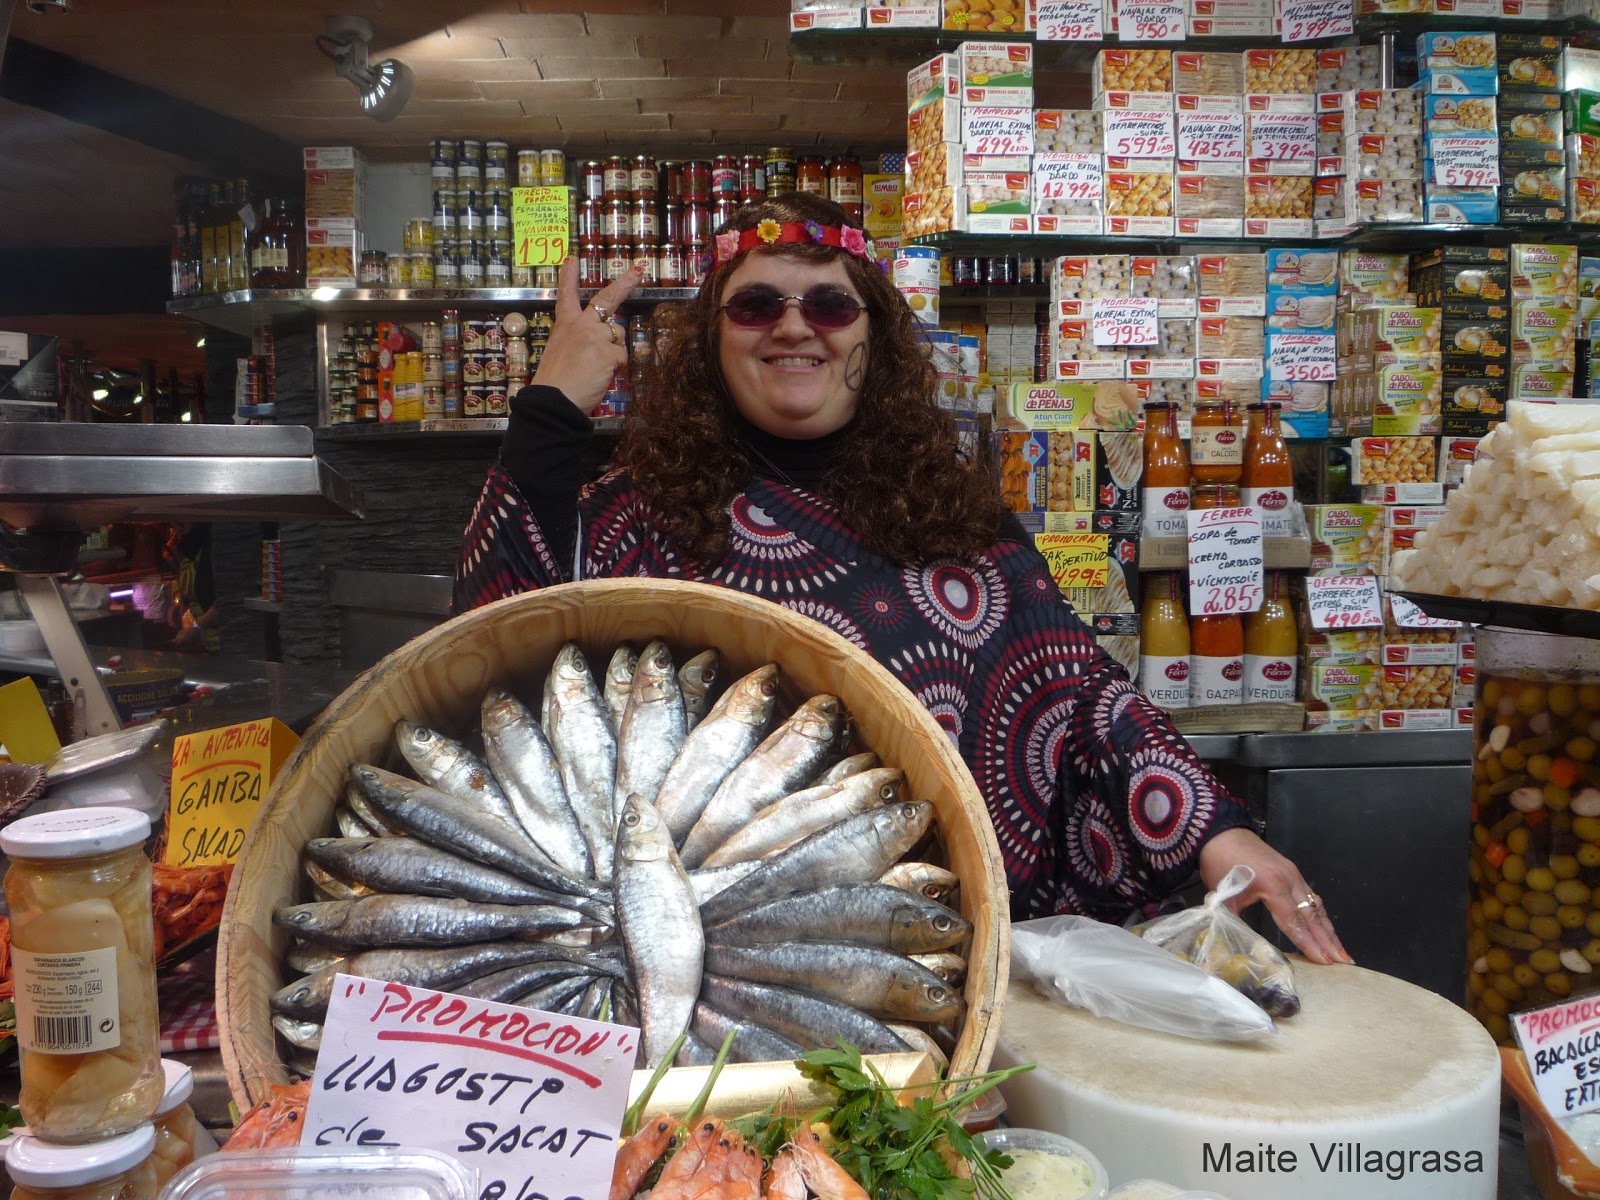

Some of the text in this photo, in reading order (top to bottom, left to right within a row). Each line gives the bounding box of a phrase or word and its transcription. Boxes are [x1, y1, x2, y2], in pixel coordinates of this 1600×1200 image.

[1118, 136, 1158, 154] 5'99
[1048, 172, 1078, 180] DARDO
[1445, 169, 1486, 186] 5'99
[525, 195, 564, 204] ESPECIAL
[519, 237, 564, 265] 1'99
[1029, 389, 1056, 399] CABO
[1260, 497, 1286, 506] Ferrer
[1200, 508, 1253, 523] FERRER
[1224, 535, 1261, 546] TOMATE
[1194, 552, 1228, 564] CREMA
[1203, 585, 1256, 614] 2.85
[1310, 586, 1376, 602] BERBERECHOS
[177, 771, 263, 816] GAMBA
[65, 984, 77, 995] 150
[87, 982, 100, 993] 244
[457, 1121, 614, 1165] SACAT
